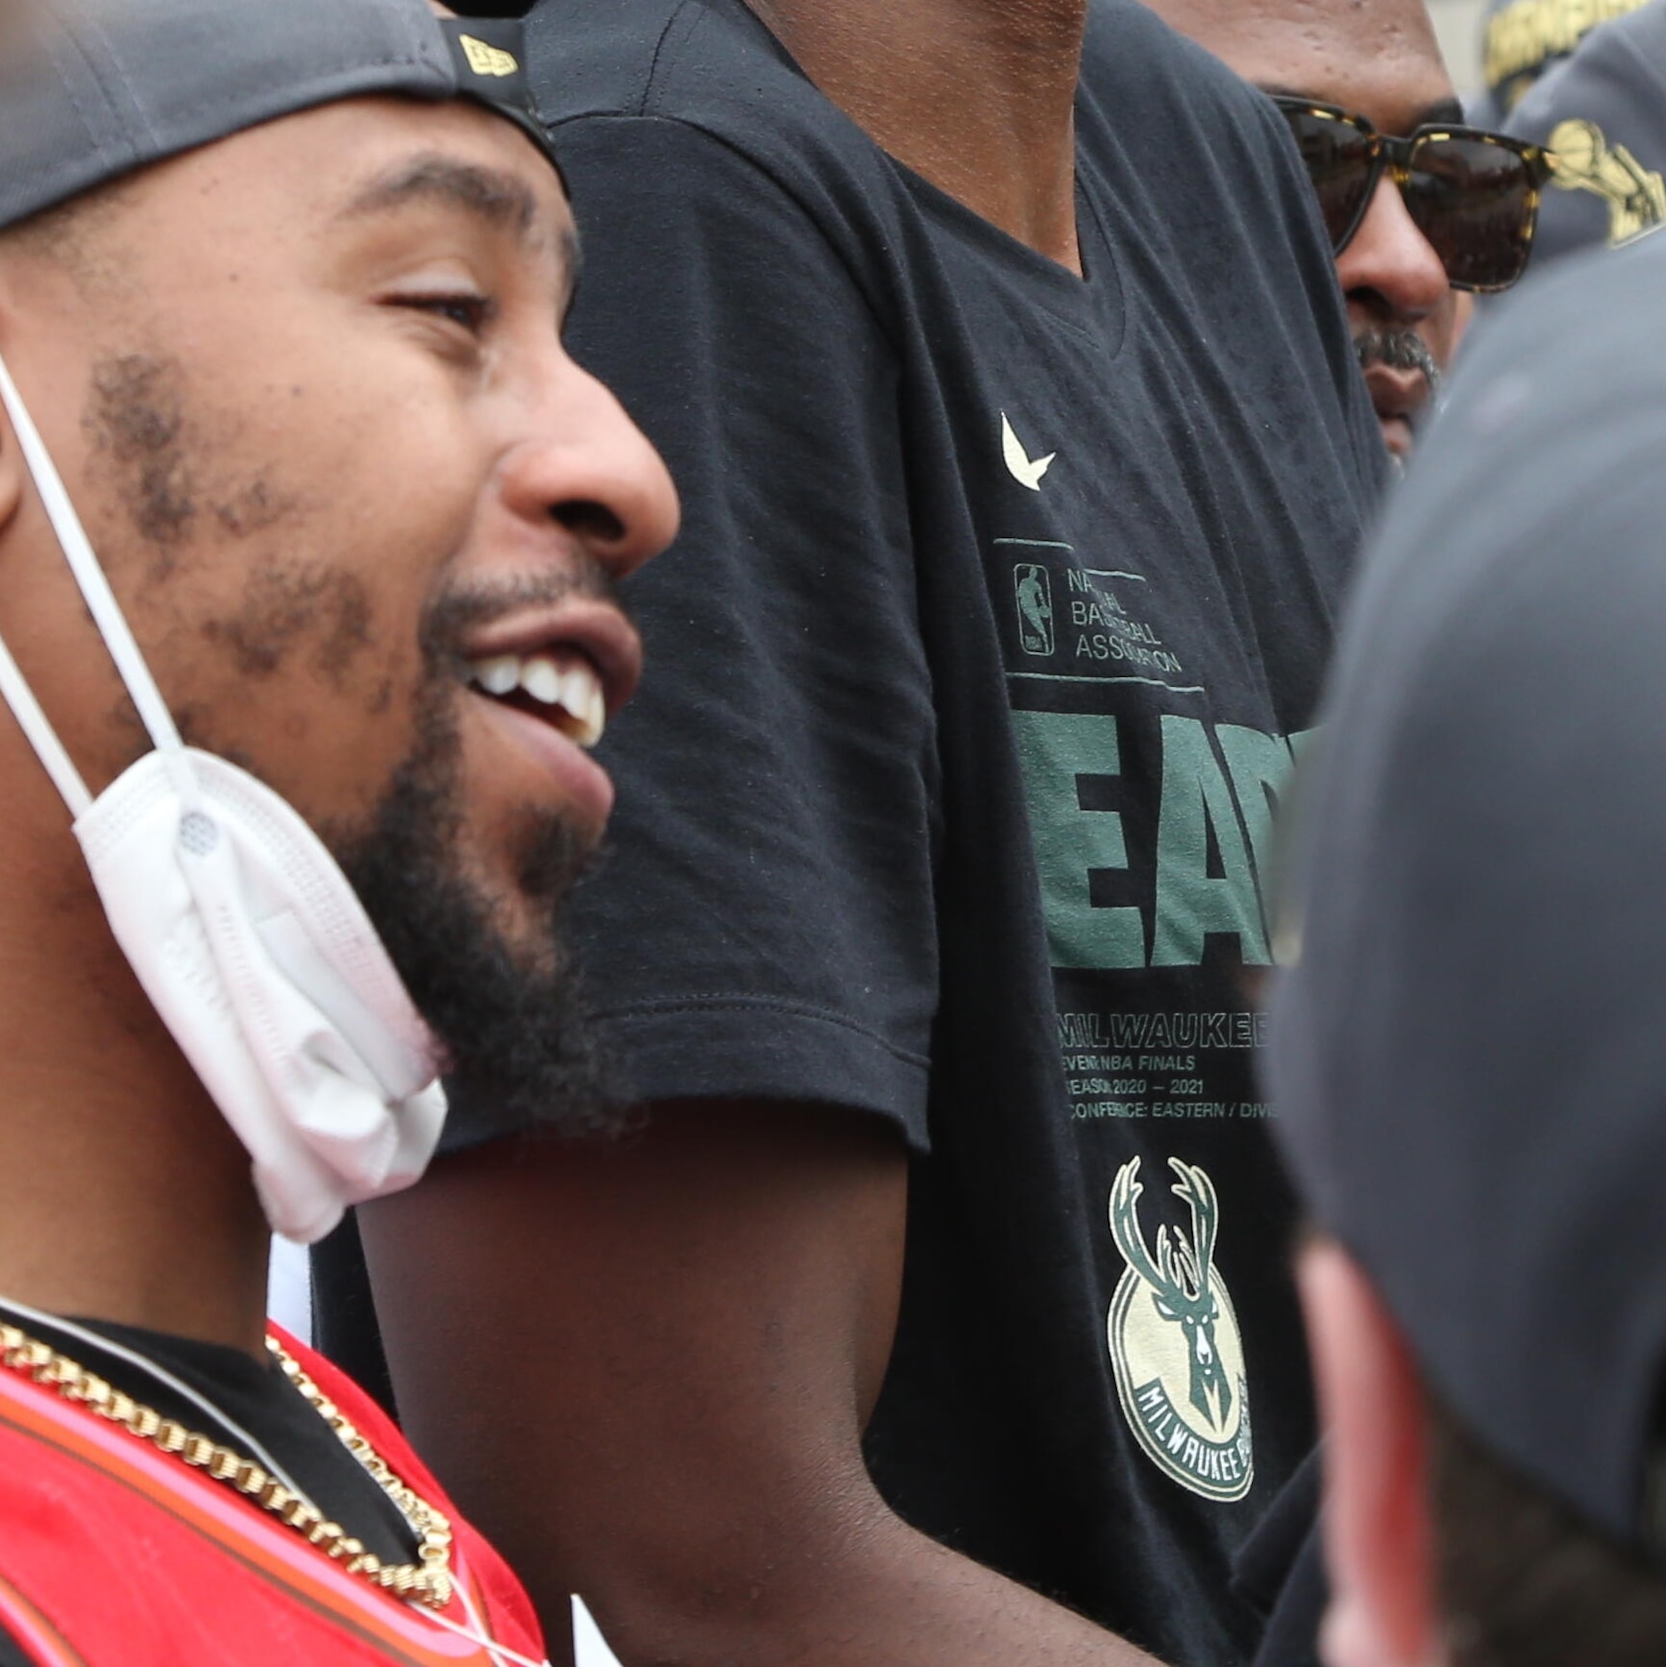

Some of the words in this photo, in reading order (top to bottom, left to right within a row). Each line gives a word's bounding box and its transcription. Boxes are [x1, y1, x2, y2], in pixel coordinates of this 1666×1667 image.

[1100, 1054, 1133, 1071] NBA
[1138, 1054, 1196, 1071] FINALS
[1113, 1078, 1147, 1095] 2020
[1169, 1078, 1204, 1095] 2021
[1152, 1101, 1226, 1119] EASTERN
[1137, 1385, 1242, 1482] MILWAUKEE
